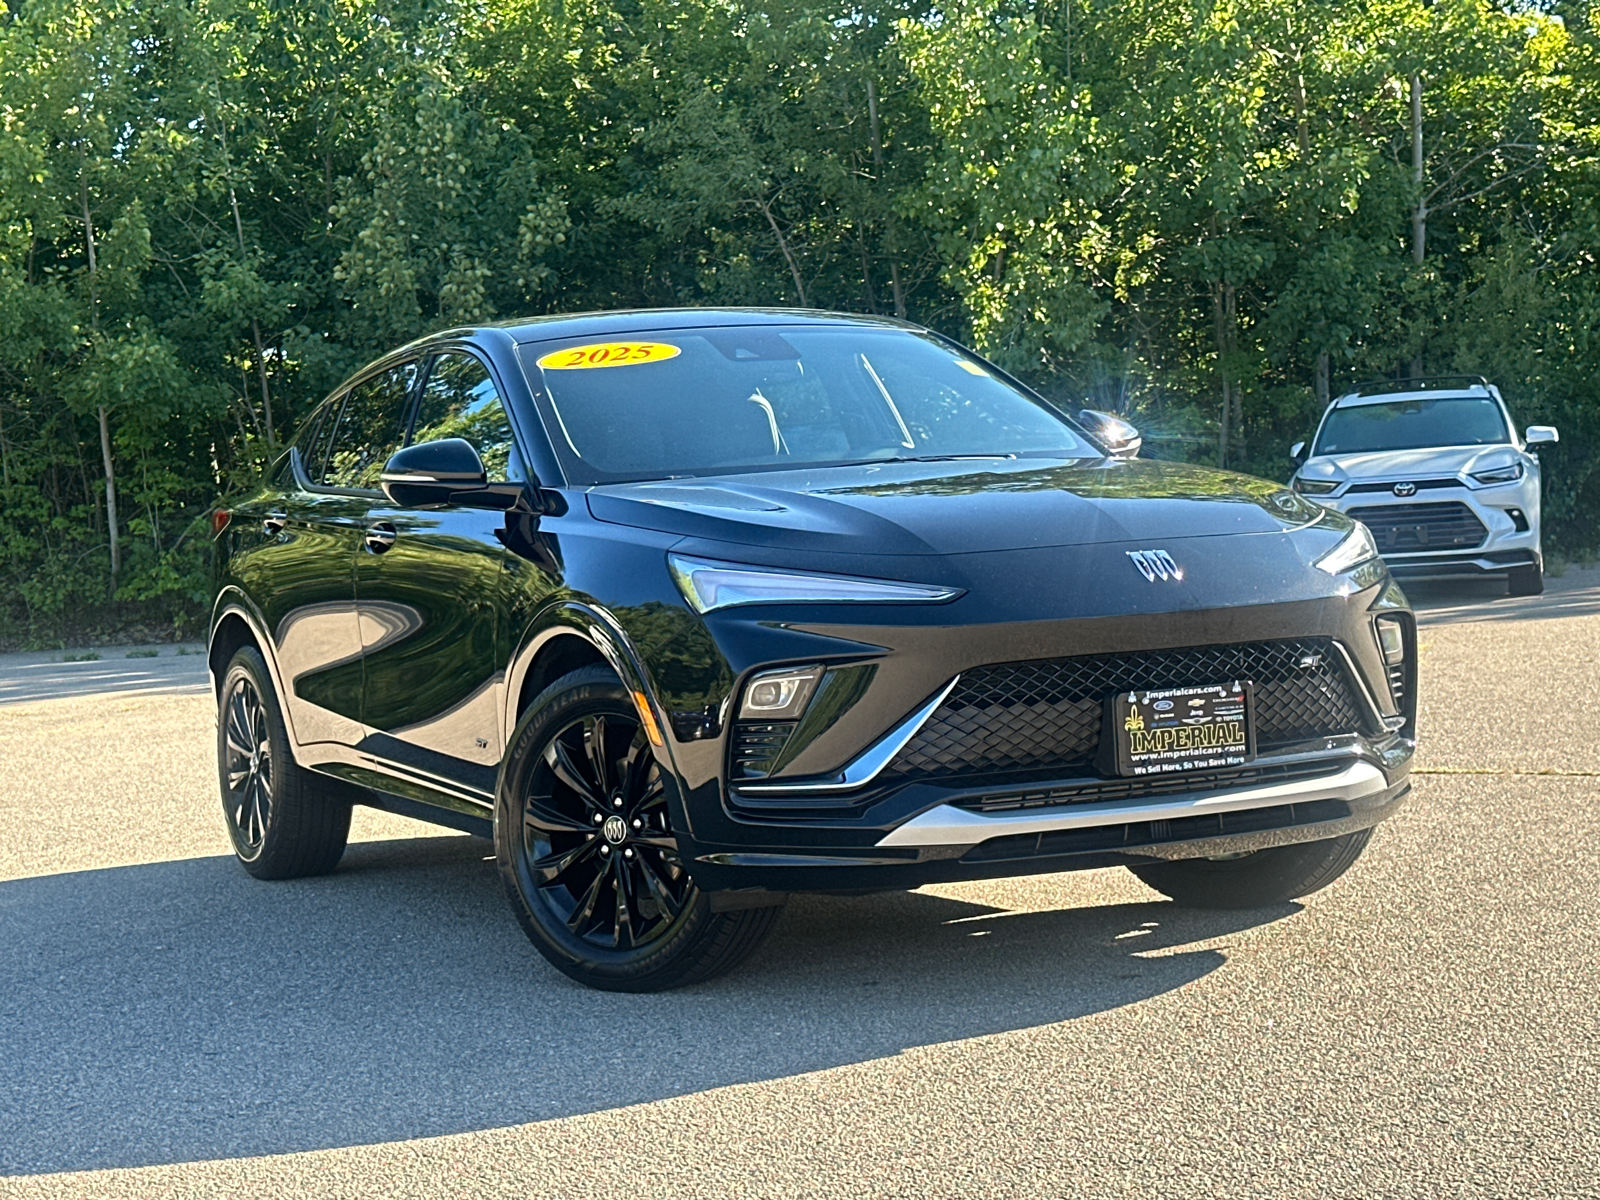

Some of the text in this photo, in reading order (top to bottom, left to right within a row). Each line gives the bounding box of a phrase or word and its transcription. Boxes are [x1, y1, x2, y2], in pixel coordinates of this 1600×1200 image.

[565, 345, 654, 367] 2025
[1146, 685, 1222, 700] Imperialcars.com
[1130, 722, 1245, 754] IMPERIAL
[1130, 745, 1246, 762] www.imperialcars.com
[1134, 766, 1146, 775] We
[1147, 764, 1160, 774] Sell
[1183, 760, 1192, 769] So
[1194, 760, 1208, 768] You
[1208, 758, 1226, 766] Save
[1226, 756, 1244, 764] More
